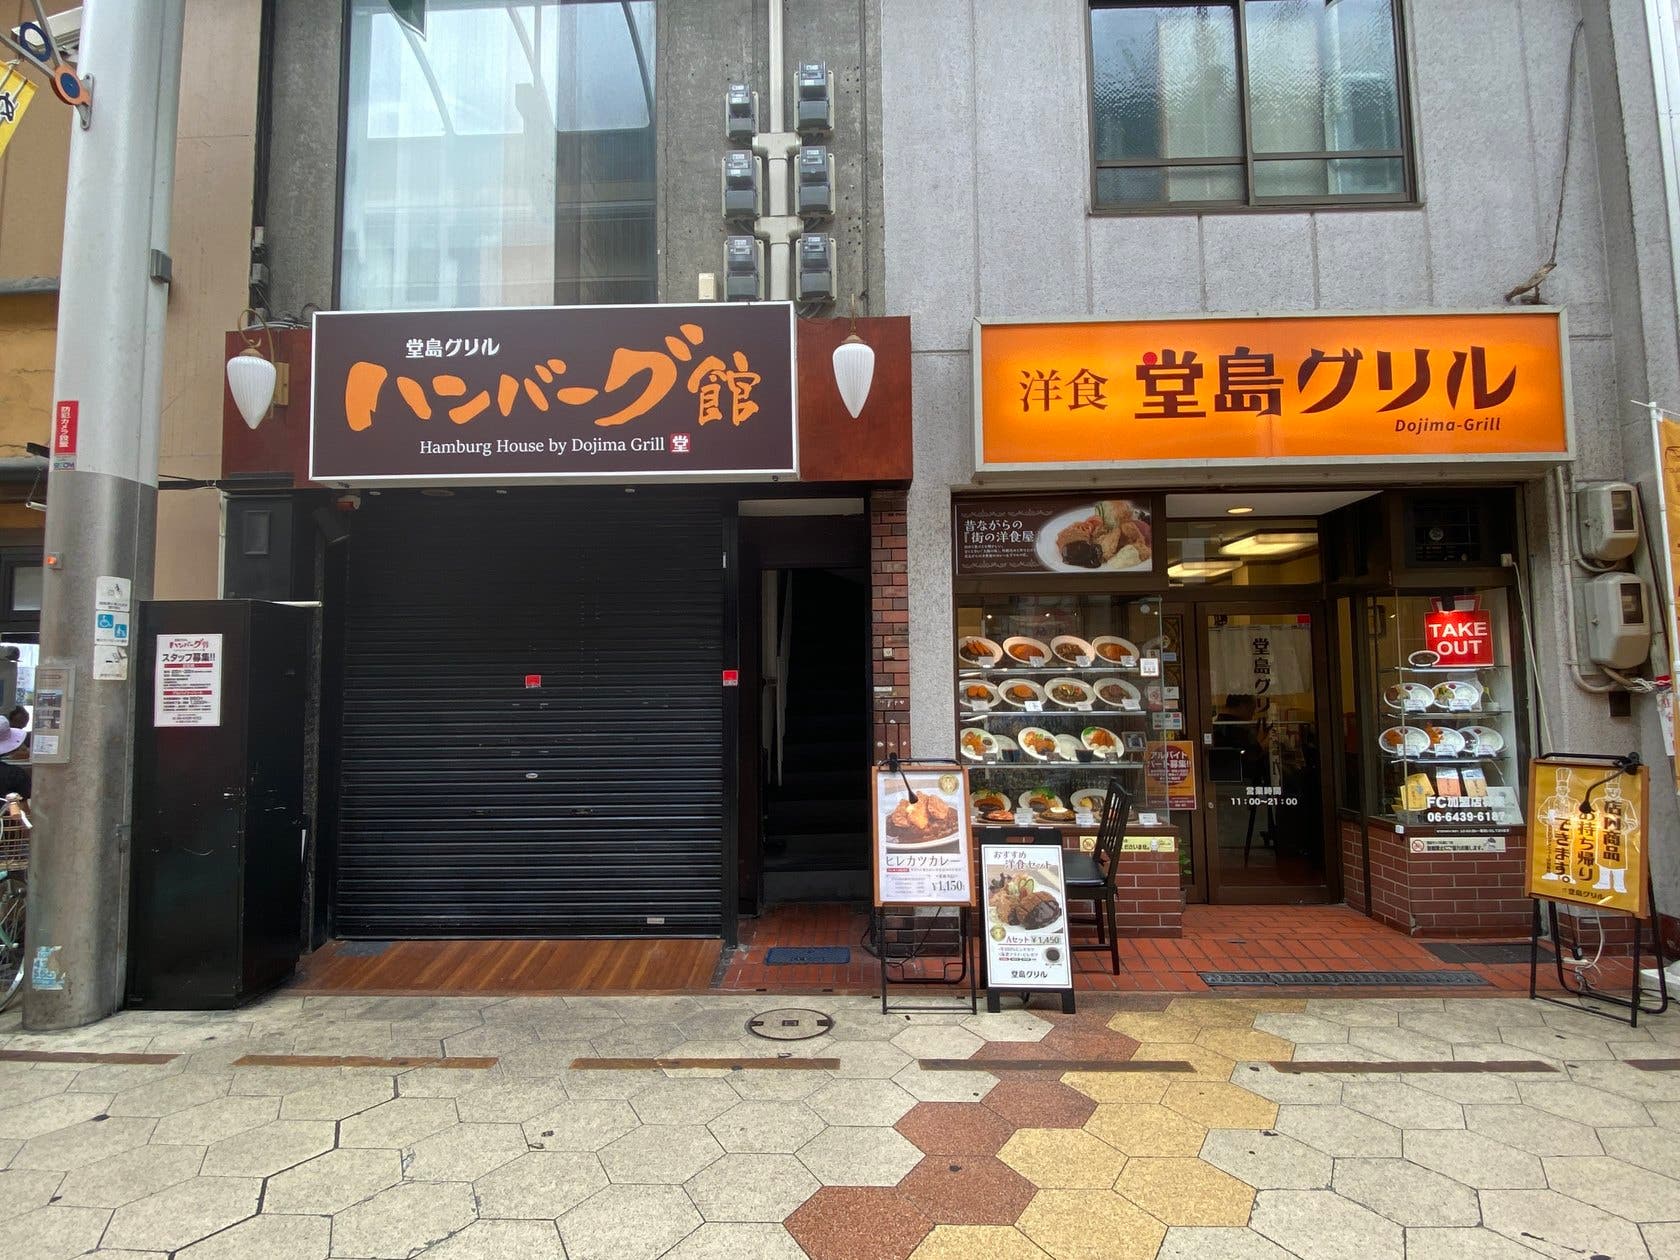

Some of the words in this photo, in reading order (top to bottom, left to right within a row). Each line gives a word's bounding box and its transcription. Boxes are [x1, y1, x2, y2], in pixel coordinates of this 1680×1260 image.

[405, 337, 500, 358] 堂島グリル
[345, 323, 761, 432] ハンバーグ館
[1018, 368, 1109, 412] 洋食
[1134, 345, 1517, 419] 堂島グリル
[1394, 417, 1501, 434] Dojima-Grill
[419, 439, 493, 457] Hamburg
[496, 438, 544, 454] House
[548, 438, 567, 456] by
[571, 437, 627, 455] Dojima
[630, 436, 665, 452] Grill
[670, 433, 691, 453] 堂
[964, 519, 1023, 532] 昔ながらの
[1428, 622, 1488, 638] TAKE
[1436, 640, 1483, 656] OUT
[1602, 800, 1622, 862] 店内商品
[885, 855, 961, 866] ヒレカツカレー
[993, 850, 1027, 859] おすすめ
[1005, 859, 1051, 870] 洋食セット
[1011, 970, 1048, 979] 堂島グリル
